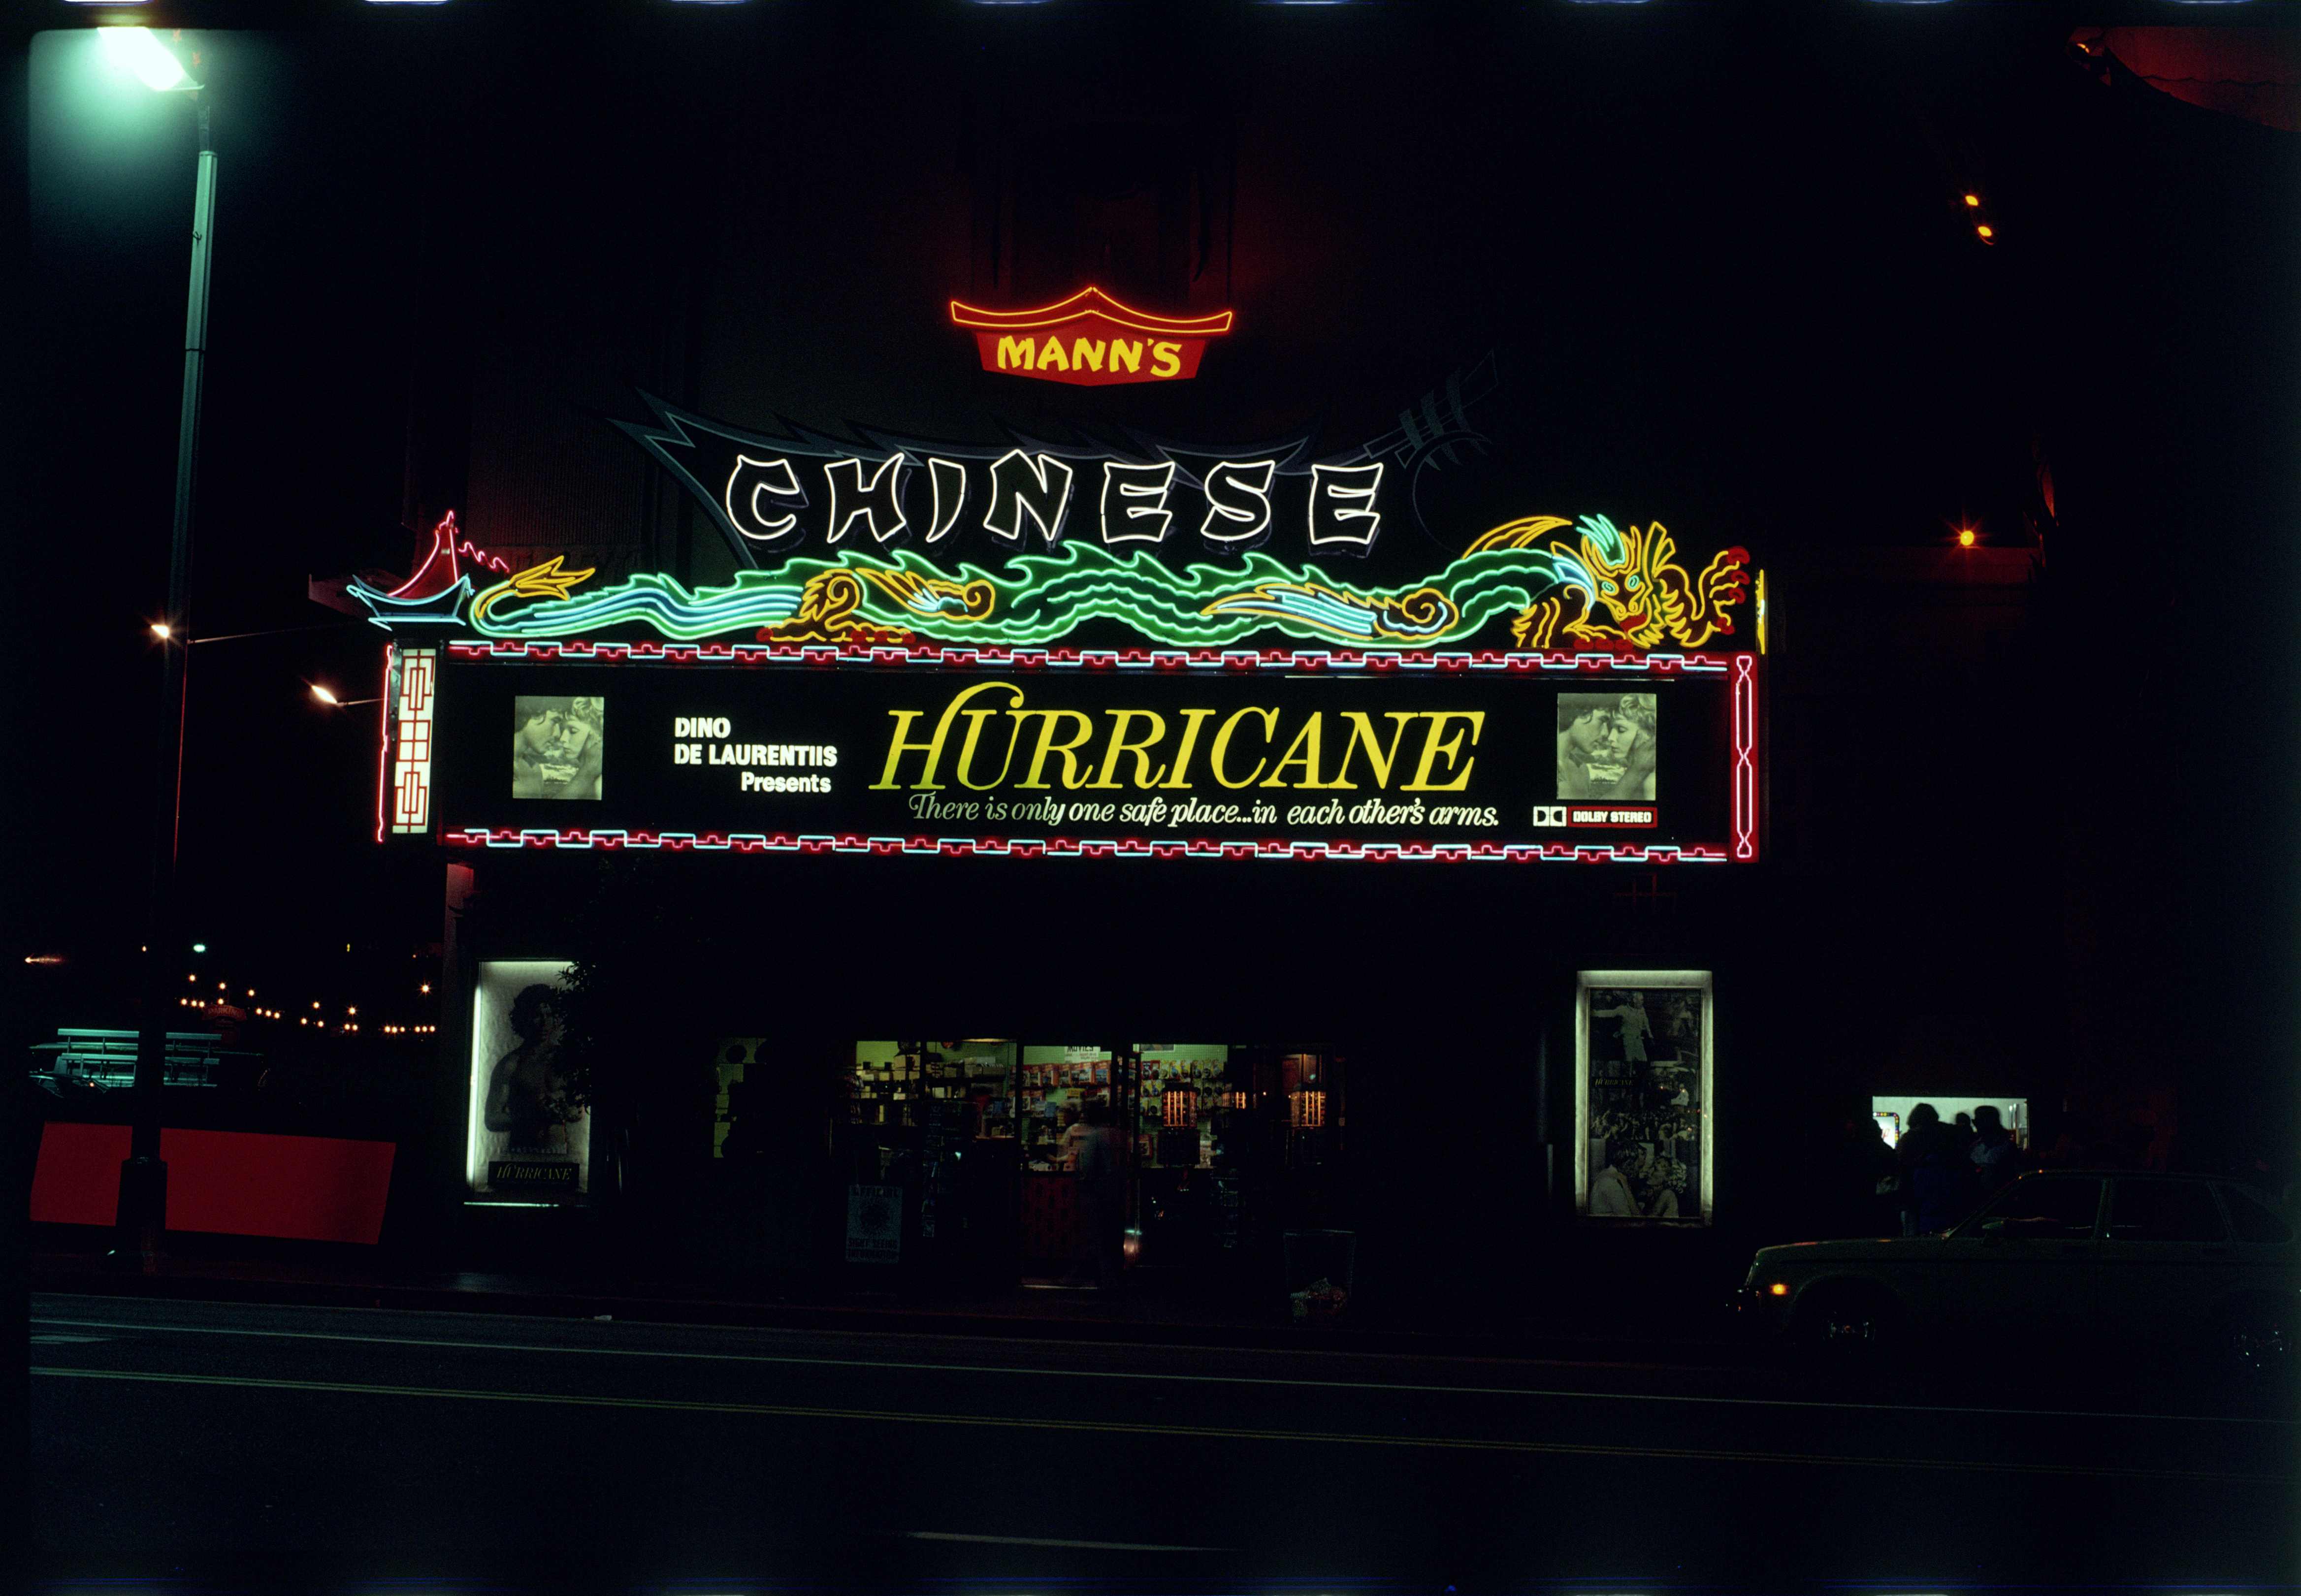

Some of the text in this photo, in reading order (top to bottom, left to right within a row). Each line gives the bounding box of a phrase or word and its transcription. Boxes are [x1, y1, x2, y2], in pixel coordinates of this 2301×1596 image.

[998, 336, 1182, 377] MANN'S
[726, 448, 1384, 545] CHINESE
[675, 717, 731, 738] DINO
[869, 681, 1486, 792] HURRICANE
[674, 743, 838, 767] DE LAURENTIIS
[741, 771, 832, 793] Presents
[909, 791, 979, 820] There
[985, 796, 1007, 820] is
[1012, 797, 1066, 826] only
[1069, 804, 1114, 821] one
[1119, 797, 1166, 826] safe
[1287, 798, 1345, 825] each
[1349, 798, 1425, 825] other's
[1429, 806, 1499, 827] arms.
[1573, 811, 1652, 823] DOLBY STEREO
[496, 1163, 572, 1181] HURRICANE
